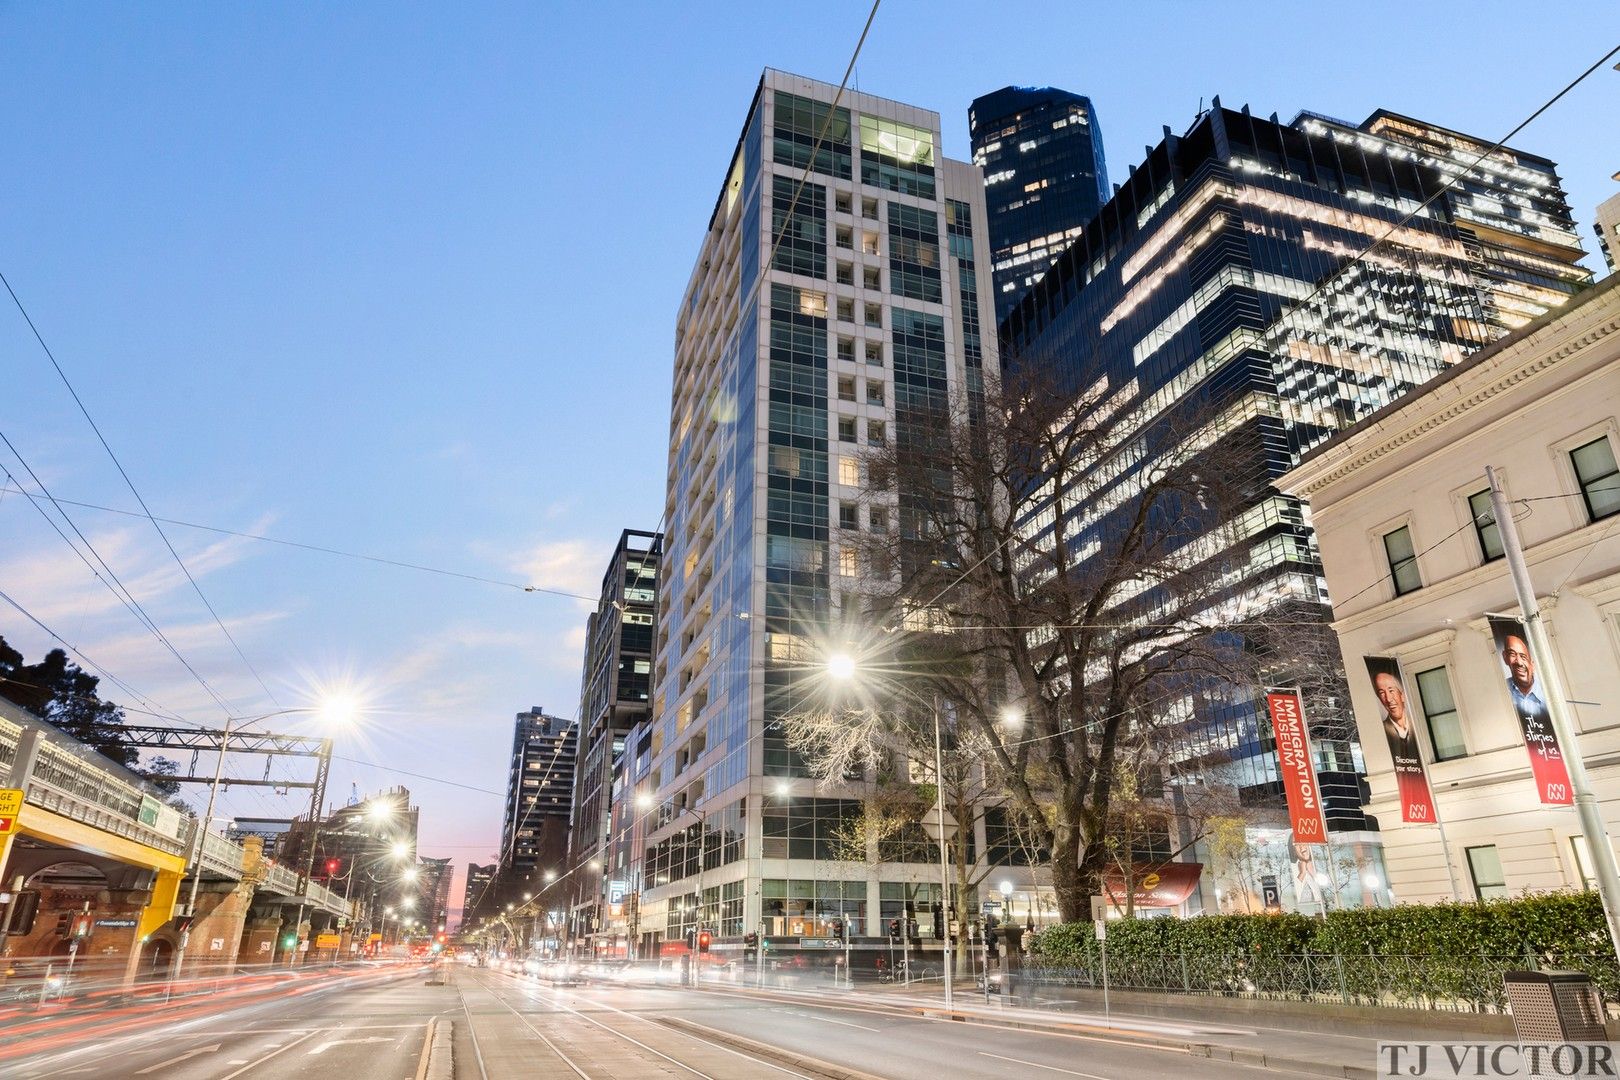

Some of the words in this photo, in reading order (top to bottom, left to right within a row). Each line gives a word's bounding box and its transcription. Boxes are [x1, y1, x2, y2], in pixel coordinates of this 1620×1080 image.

[1525, 714, 1545, 729] The
[1273, 699, 1295, 766] MUSEUM
[1525, 724, 1555, 743] stories
[1285, 700, 1314, 808] IMMIGRATION
[1537, 738, 1549, 761] of
[1395, 755, 1418, 764] Discover
[1395, 765, 1406, 773] your
[0, 803, 16, 812] HT
[612, 891, 622, 902] P
[1266, 890, 1275, 905] P
